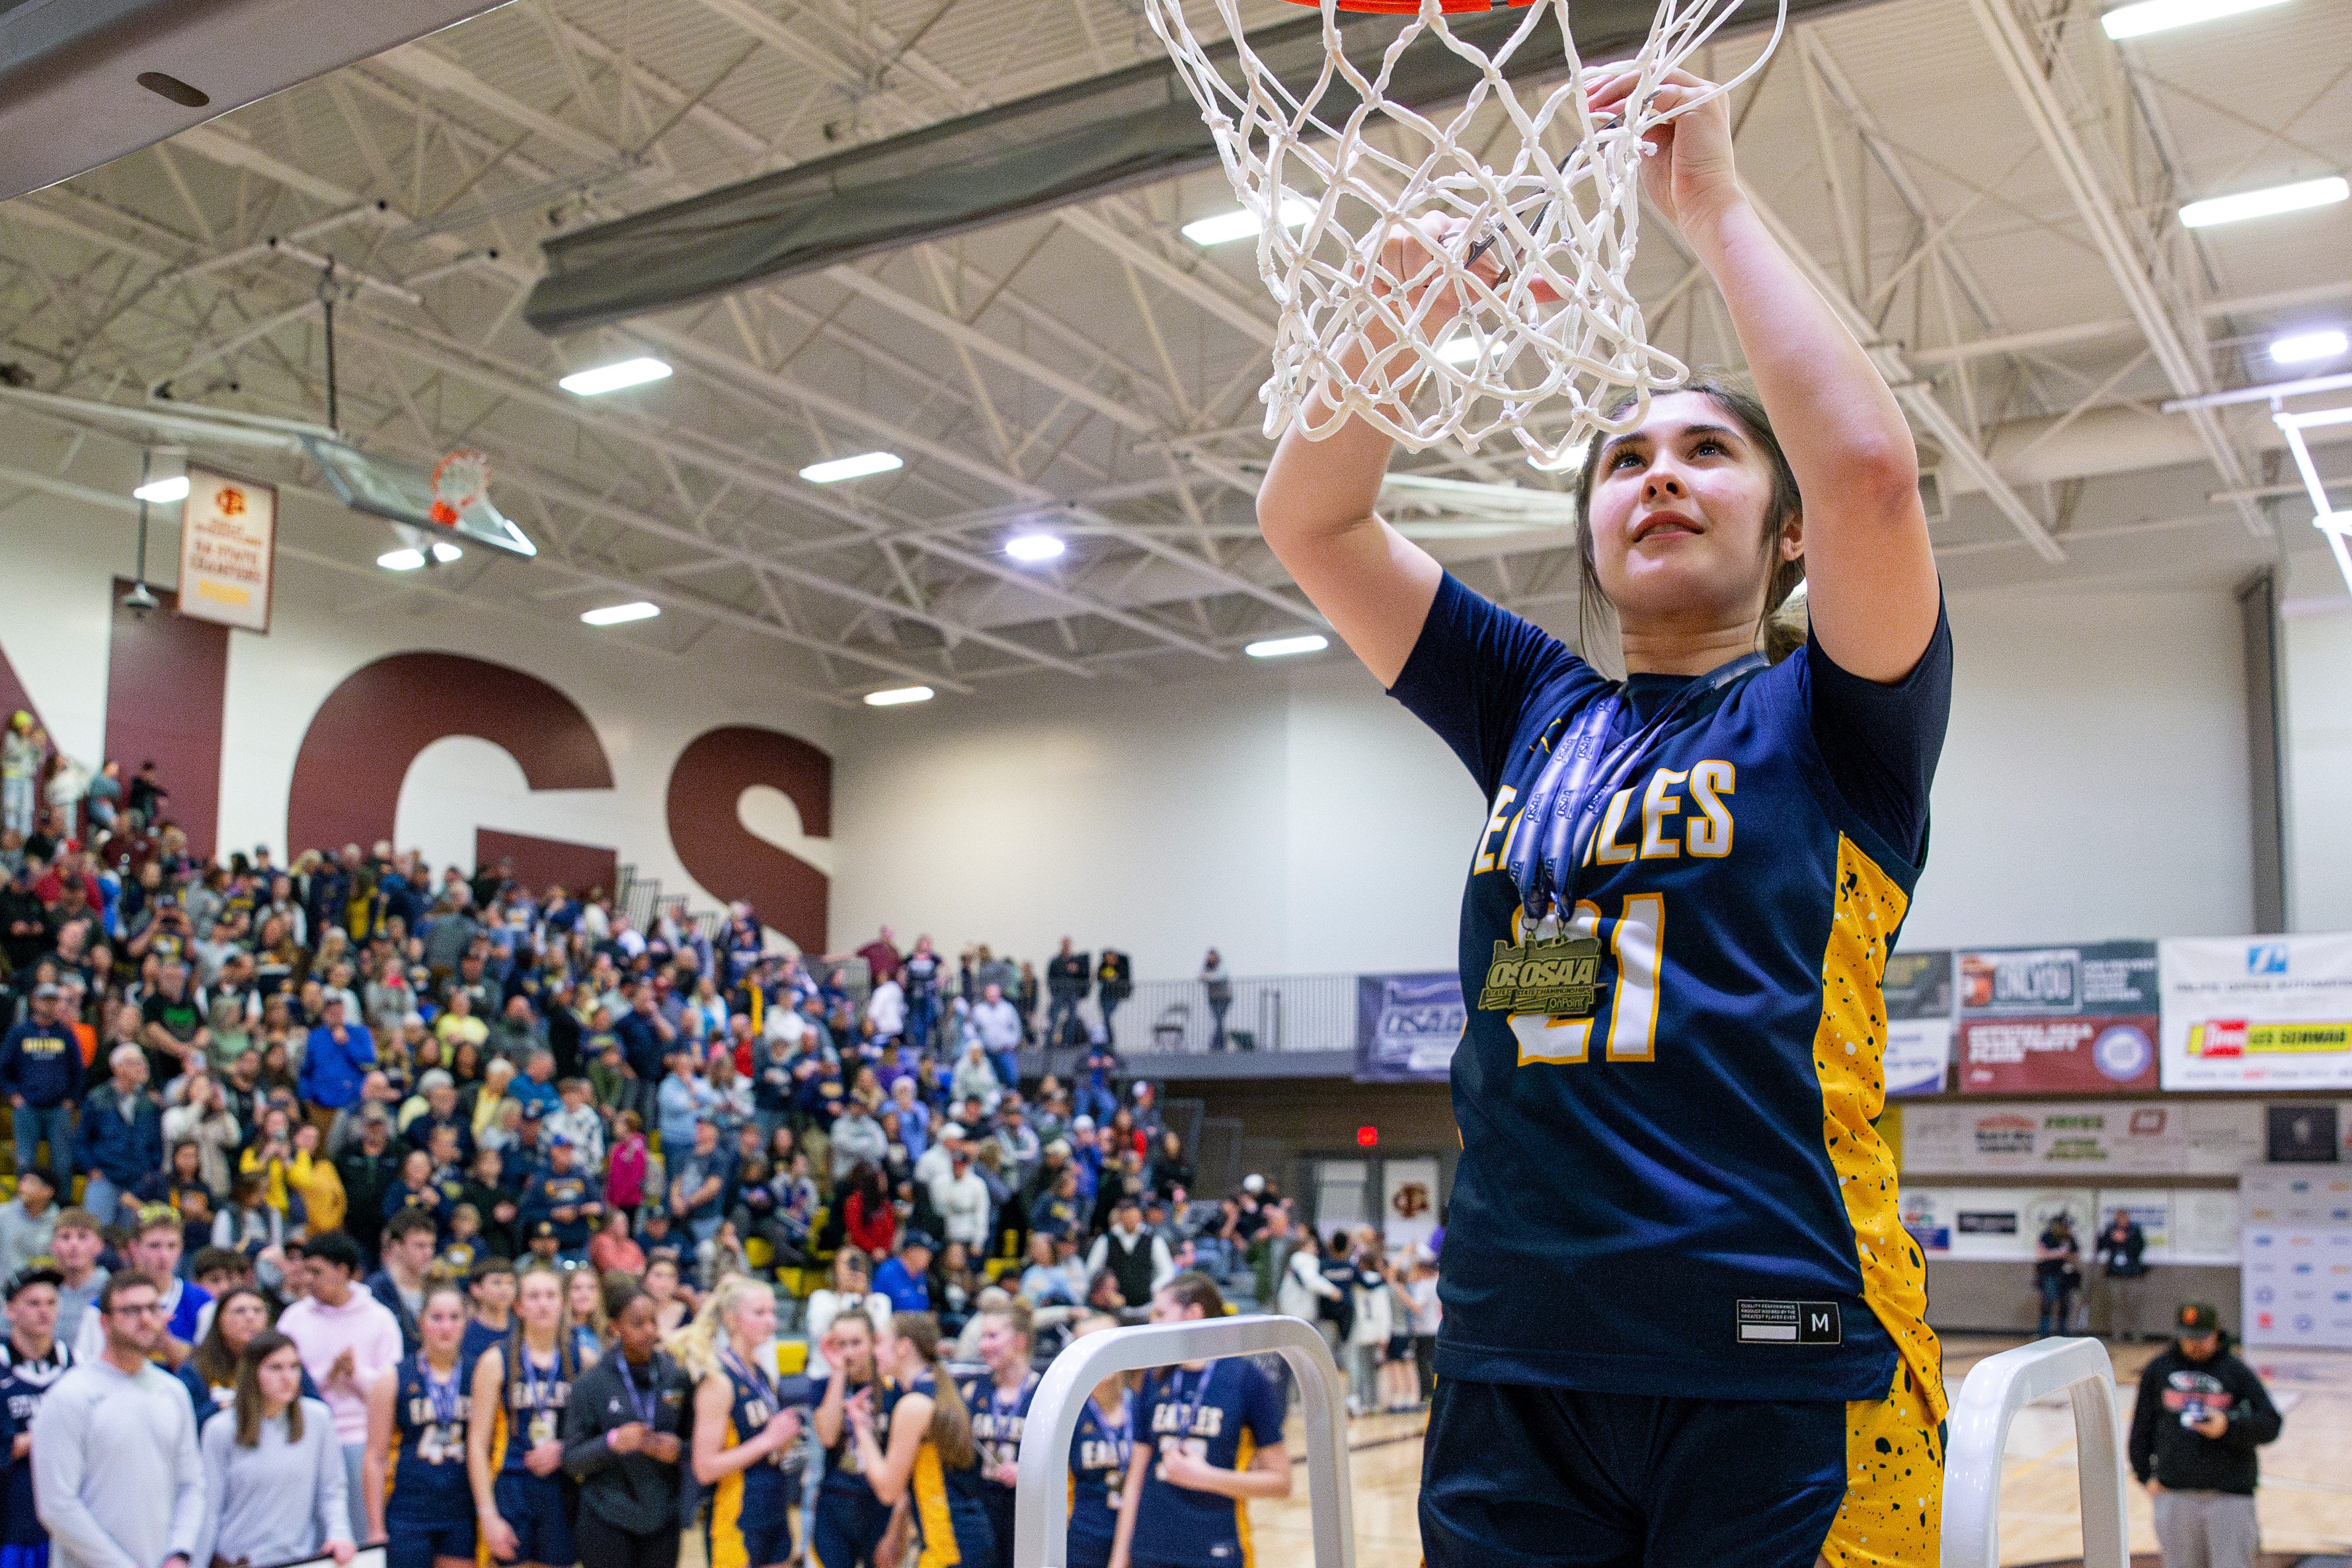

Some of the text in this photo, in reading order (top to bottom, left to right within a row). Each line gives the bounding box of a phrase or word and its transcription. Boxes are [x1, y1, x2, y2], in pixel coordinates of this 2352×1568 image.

[1473, 759, 1736, 875] ELES
[1507, 892, 1665, 1067] 21
[1518, 959, 1595, 988] OSAA
[1811, 1313, 1829, 1333] M
